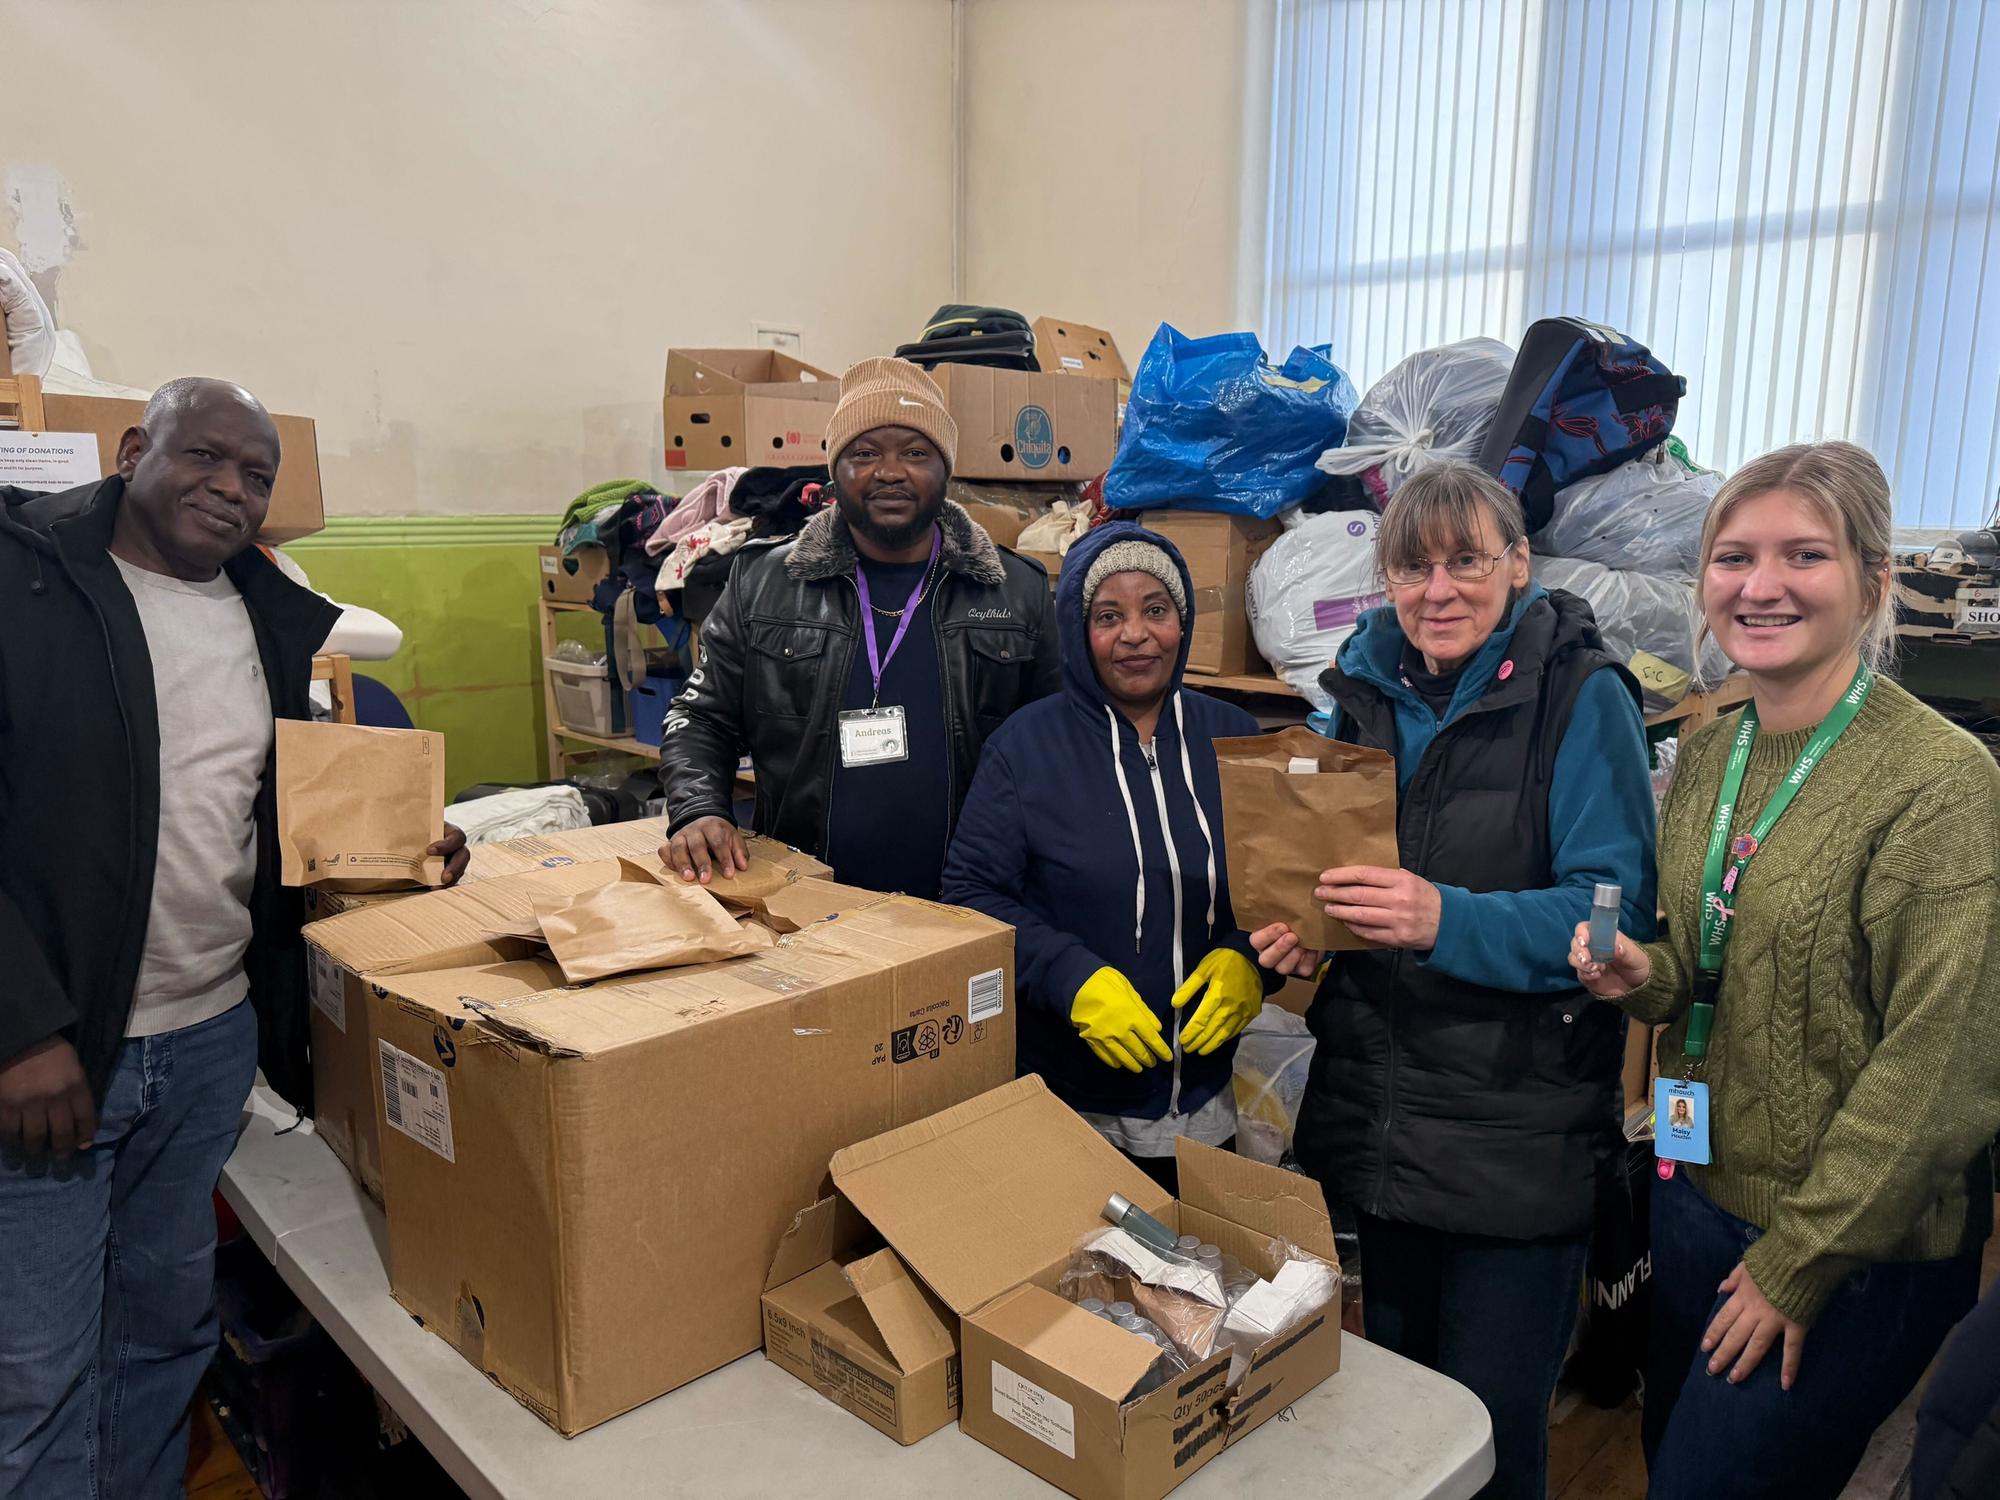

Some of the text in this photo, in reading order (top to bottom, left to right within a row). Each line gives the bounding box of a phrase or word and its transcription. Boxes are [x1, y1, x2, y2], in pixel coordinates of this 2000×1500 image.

[0, 446, 15, 454] ING
[28, 447, 75, 455] DONATIONS
[1017, 440, 1052, 458] Chiquita
[1846, 679, 1867, 705] WHS
[1737, 720, 1755, 746] WHS
[1788, 757, 1814, 784] WHS
[1716, 804, 1731, 831] WHS
[1709, 919, 1726, 946] WHS
[871, 1054, 886, 1065] PAP
[1672, 1127, 1691, 1137] Maisy
[1593, 1249, 1652, 1310] FLANN
[1173, 1402, 1192, 1420] Qty
